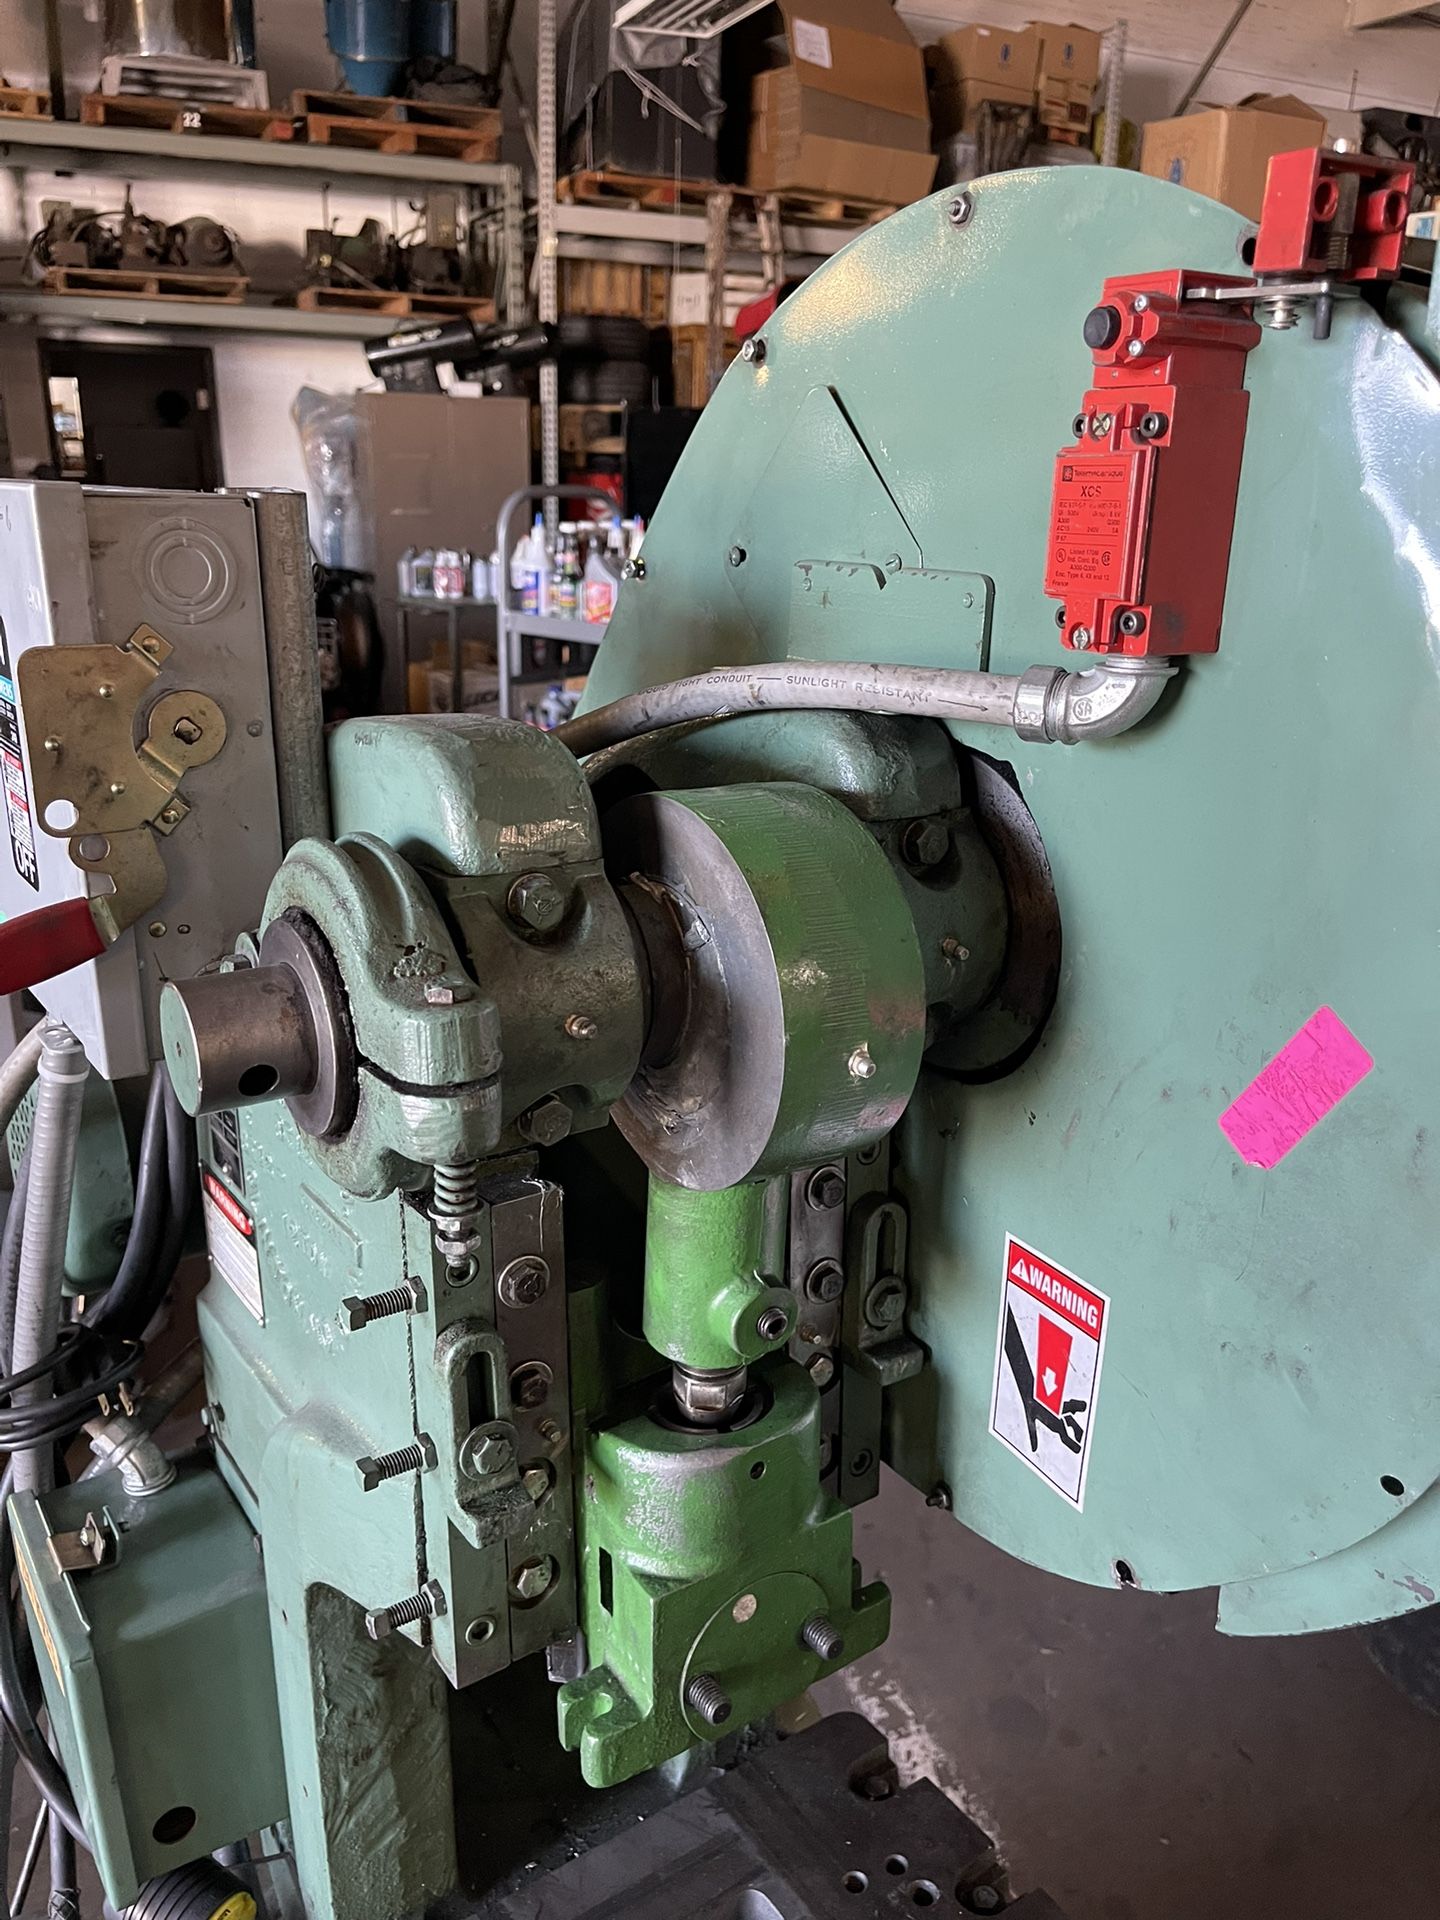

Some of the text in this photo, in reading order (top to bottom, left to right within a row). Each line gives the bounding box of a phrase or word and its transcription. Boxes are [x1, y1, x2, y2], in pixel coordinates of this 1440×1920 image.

[1080, 485, 1101, 498] XCS
[673, 677, 703, 689] TIGHT
[706, 674, 753, 684] CONDUIT
[786, 675, 847, 689] SUNLIGHT
[855, 682, 934, 703] RESISTANT
[1028, 1263, 1099, 1330] WARNING
